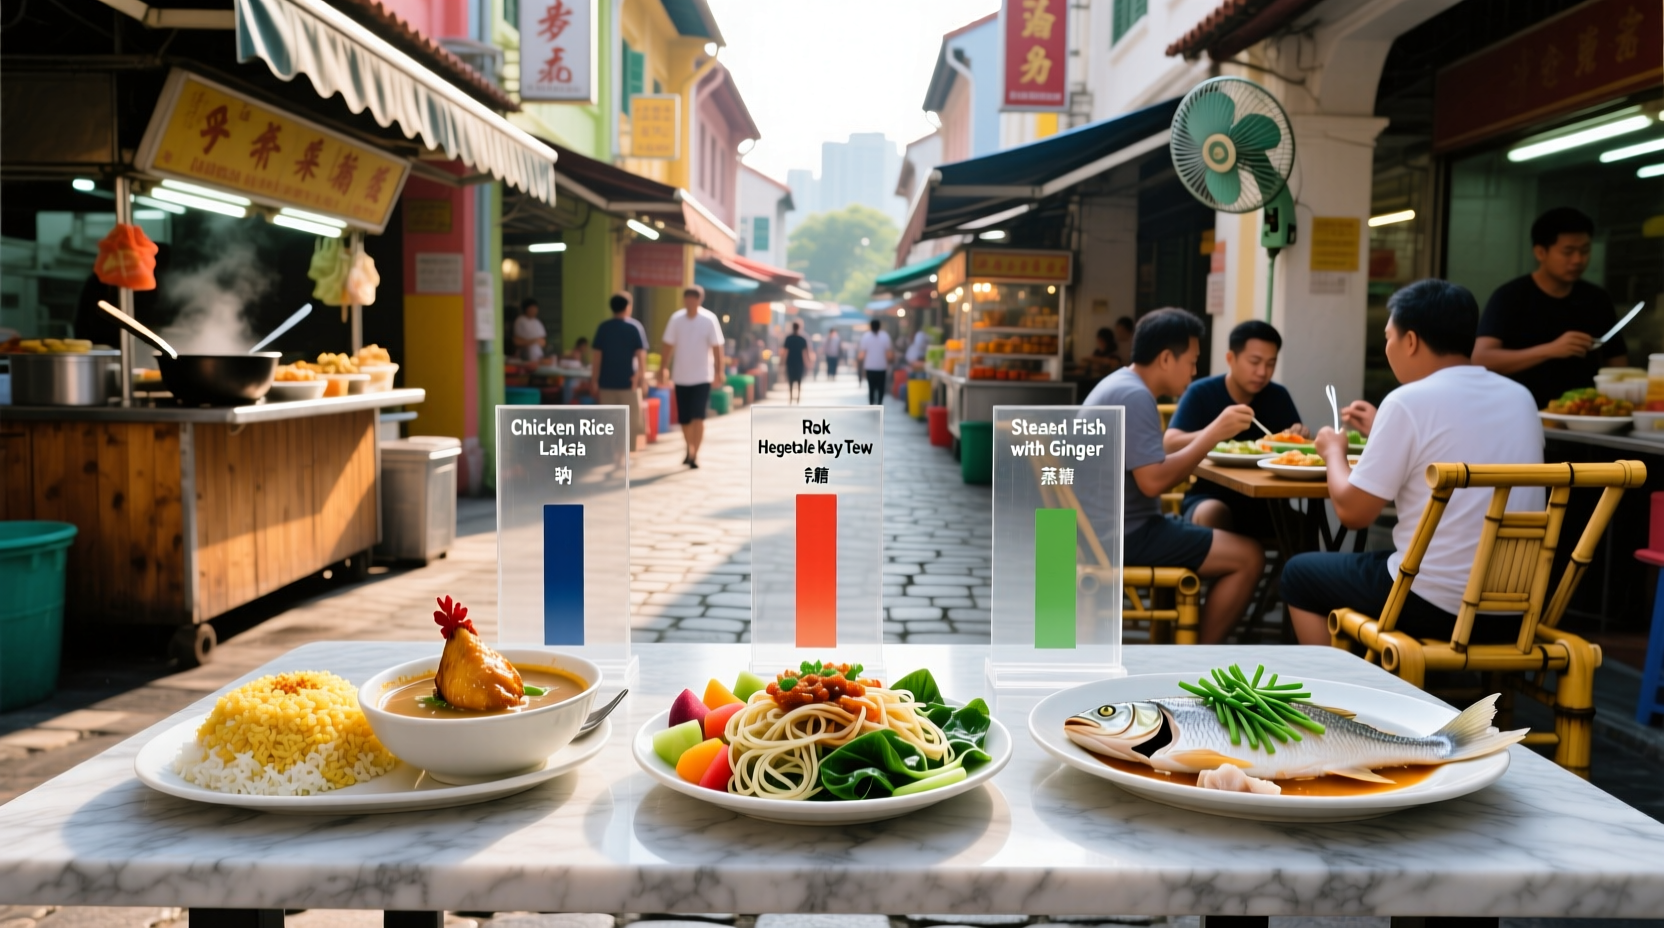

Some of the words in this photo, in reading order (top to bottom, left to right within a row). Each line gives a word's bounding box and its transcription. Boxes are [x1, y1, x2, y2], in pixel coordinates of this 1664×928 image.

[510, 418, 575, 436] Chicken
[579, 418, 615, 436] Rice
[1072, 418, 1106, 436] Fish
[817, 439, 843, 459] Kay
[844, 439, 874, 455] Tew
[1010, 439, 1045, 457] with
[1049, 439, 1104, 461] Ginger
